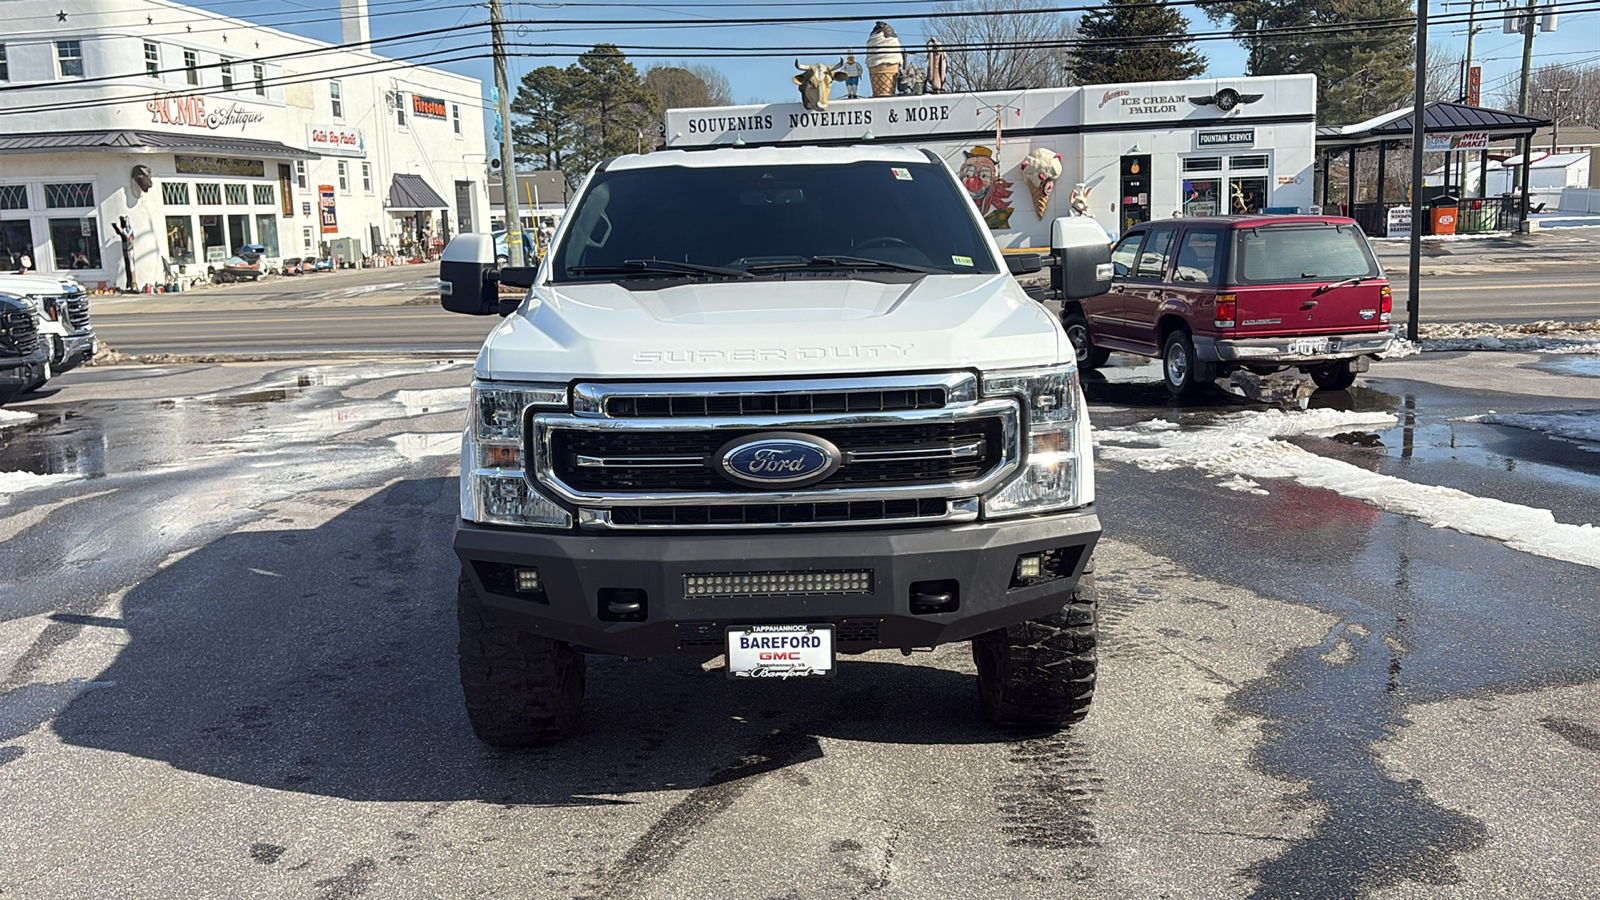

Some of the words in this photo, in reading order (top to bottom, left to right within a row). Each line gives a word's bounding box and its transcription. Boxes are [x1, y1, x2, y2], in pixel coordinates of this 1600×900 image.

[1471, 68, 1479, 102] ACME
[1121, 97, 1140, 106] ICE
[1142, 95, 1186, 104] CREAM
[146, 91, 207, 128] ACME
[207, 102, 265, 132] Antiques
[1129, 105, 1177, 115] PARLOR
[688, 115, 773, 133] SOUVENIRS
[789, 110, 872, 128] NOVELTIES
[888, 108, 899, 122] &
[905, 105, 949, 121] MORE
[329, 131, 338, 147] Boy
[1200, 134, 1228, 143] FOUNTAIN
[1229, 133, 1252, 141] SERVICE
[1456, 140, 1487, 148] SHAKES
[323, 211, 335, 224] TEA
[632, 349, 786, 363] SUPER
[796, 343, 914, 360] DUTY
[749, 448, 806, 474] Ford
[740, 636, 821, 649] BAREFORD
[759, 652, 800, 660] GMC
[751, 666, 812, 680] Bareford
